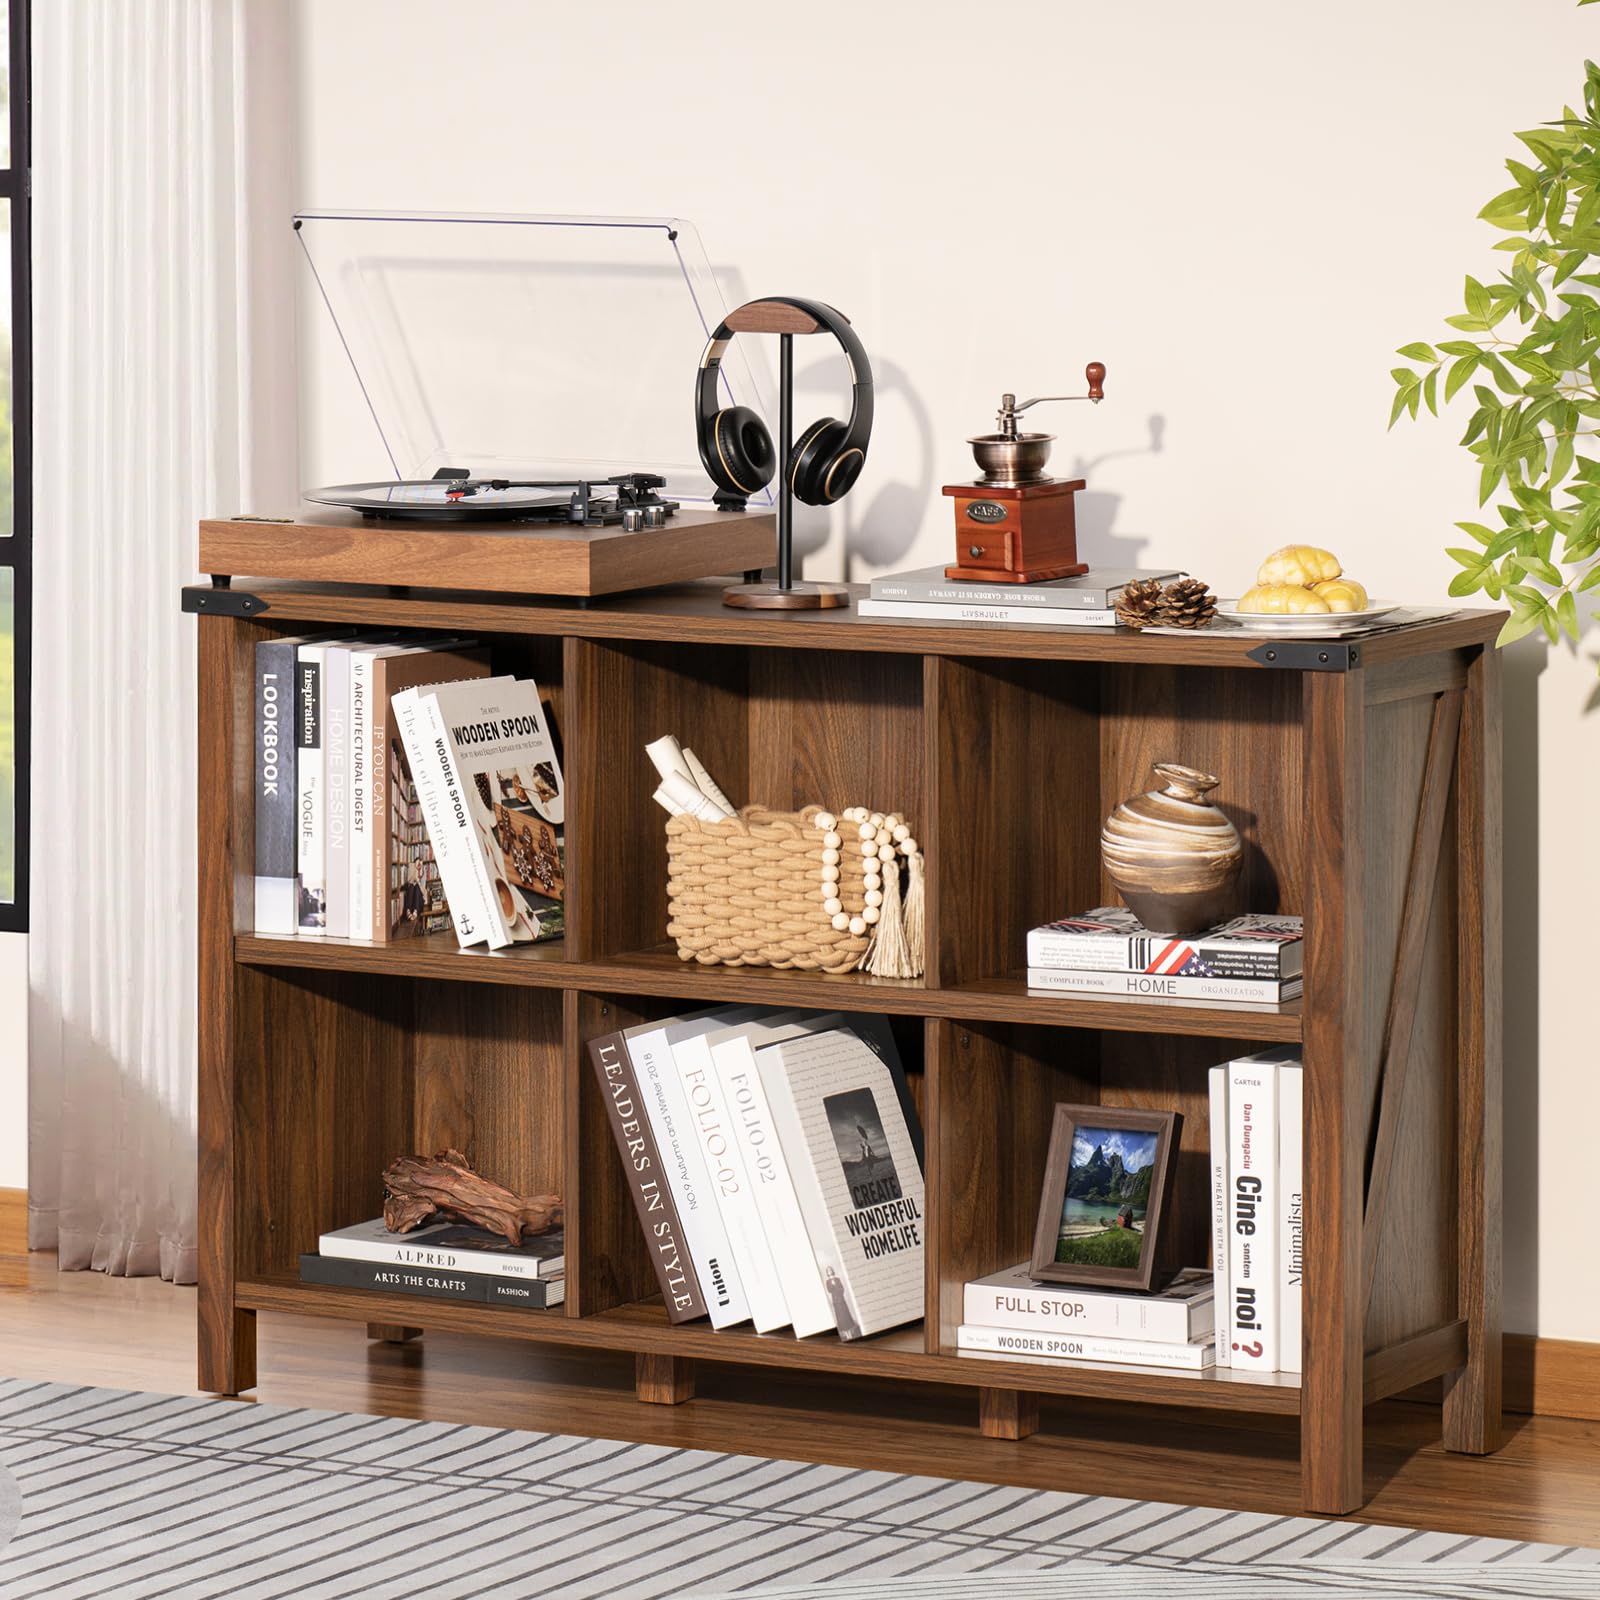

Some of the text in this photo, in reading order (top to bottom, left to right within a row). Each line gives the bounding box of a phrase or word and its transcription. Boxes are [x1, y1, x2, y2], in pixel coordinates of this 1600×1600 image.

[881, 587, 908, 596] FASHION
[928, 589, 956, 599] ANYWAY
[974, 591, 1001, 600] GARDEN
[961, 610, 1009, 619] LIVSHJULET
[302, 669, 316, 745] inspiration
[263, 673, 278, 797] LOOKBOOK
[354, 682, 364, 785] ARCHITECTURAL
[452, 715, 540, 746] WOODEN SPOON
[328, 708, 345, 849] HOME DESIGN
[373, 726, 384, 817] IF YOU CAN
[401, 705, 448, 858] The art of libraries
[435, 738, 466, 828] WOODEN SPOON
[303, 790, 313, 838] VOGUE
[354, 788, 364, 833] DIGEST
[1126, 978, 1177, 995] HOME
[1200, 985, 1265, 997] ORGANIZATION
[643, 1052, 658, 1079] 2018
[651, 1077, 670, 1112] Winter
[1234, 1078, 1262, 1087] CARTIER
[664, 1113, 678, 1139] and
[685, 1069, 740, 1198] FOLIO-02
[731, 1072, 777, 1184] FOLIO-02
[1241, 1103, 1253, 1170] Dan Dungaciu
[671, 1138, 690, 1181] Autumn
[1215, 1166, 1222, 1179] MY
[599, 1043, 693, 1312] LEADERS IN STYLE
[853, 1176, 899, 1207] CREATE
[1215, 1182, 1223, 1212] HEART
[1236, 1175, 1262, 1236] Cine
[844, 1197, 921, 1237] WONDERFUL
[861, 1224, 921, 1260] HOMELIFE
[1216, 1227, 1224, 1250] WITH
[1288, 1193, 1303, 1287] Minimalista
[395, 1250, 457, 1267] ALPRED
[502, 1264, 525, 1273] HOME
[1217, 1253, 1225, 1272] YOU
[374, 1272, 466, 1291] ARTS THE CRAFTS
[497, 1286, 530, 1297] FASHION
[708, 1257, 731, 1307] Union
[995, 1296, 1088, 1319] FULL STOP.
[1236, 1287, 1262, 1331] noi
[998, 1336, 1043, 1353] WOODEN
[1047, 1340, 1083, 1355] SPOON
